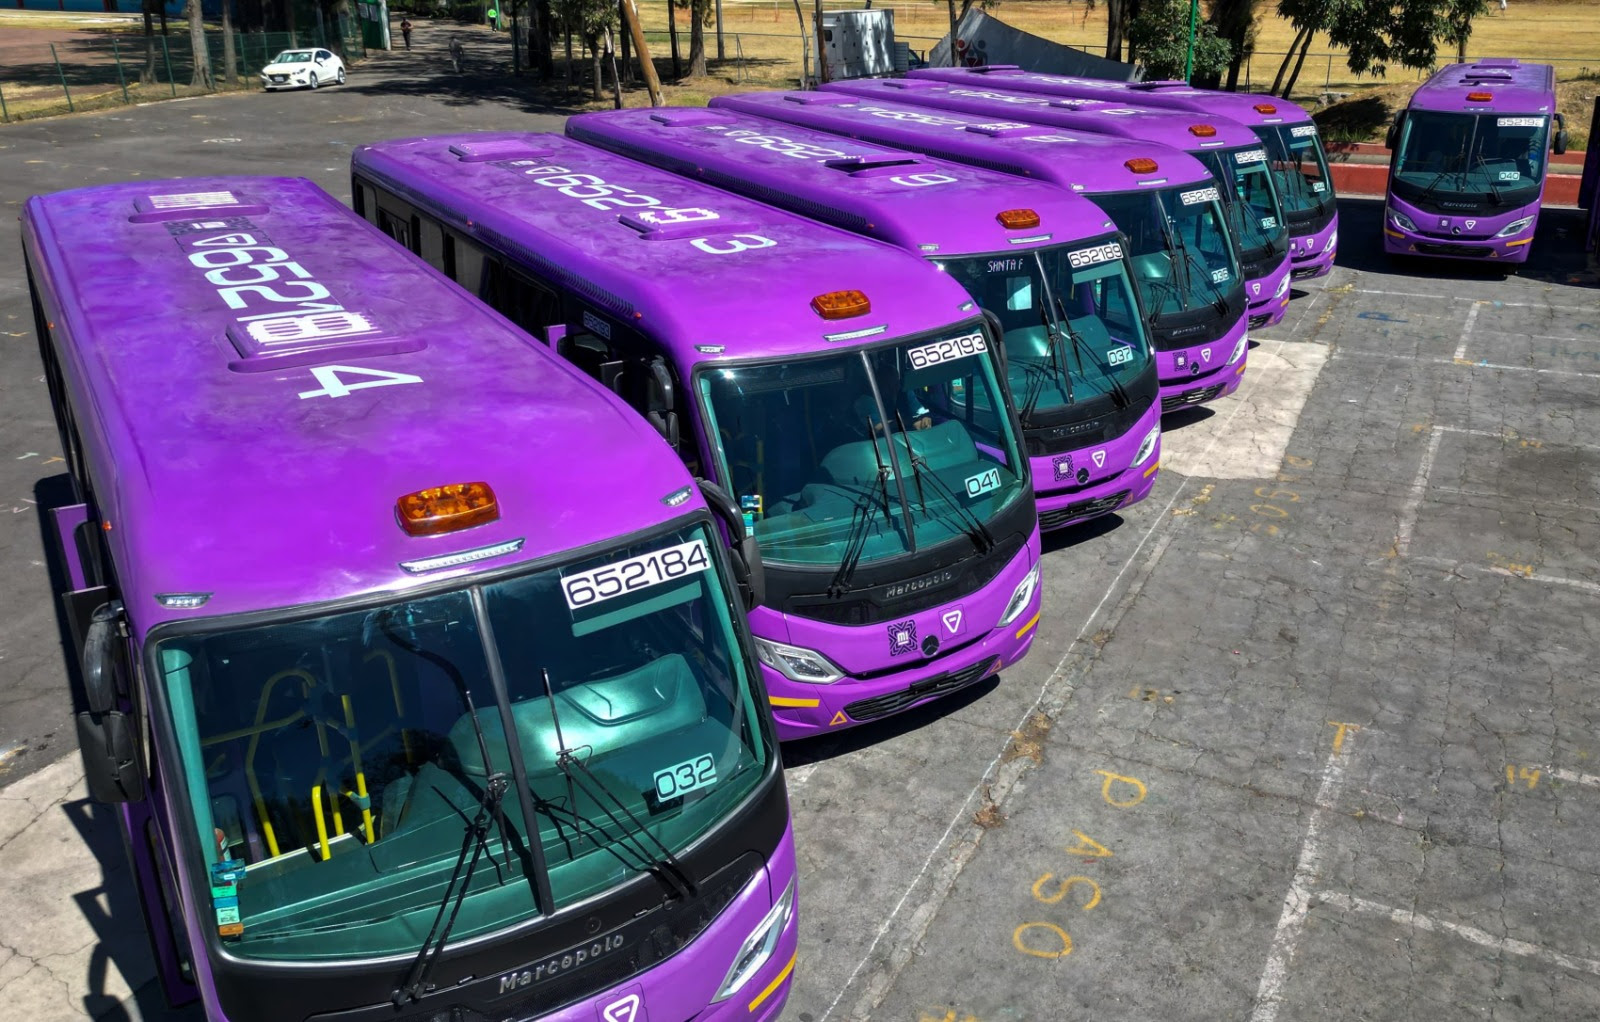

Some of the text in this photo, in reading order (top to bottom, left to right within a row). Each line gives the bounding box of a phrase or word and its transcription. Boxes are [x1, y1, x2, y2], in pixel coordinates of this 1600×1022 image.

[1499, 172, 1519, 180] 040
[987, 259, 1016, 272] SANTA
[1069, 244, 1122, 267] 652189
[910, 336, 986, 368] 652193
[1109, 347, 1132, 366] 037
[966, 469, 1001, 496] 041
[565, 542, 709, 606] 652184
[886, 570, 953, 599] Marcopolo
[654, 756, 716, 800] 032
[499, 932, 625, 994] Marcopolo
